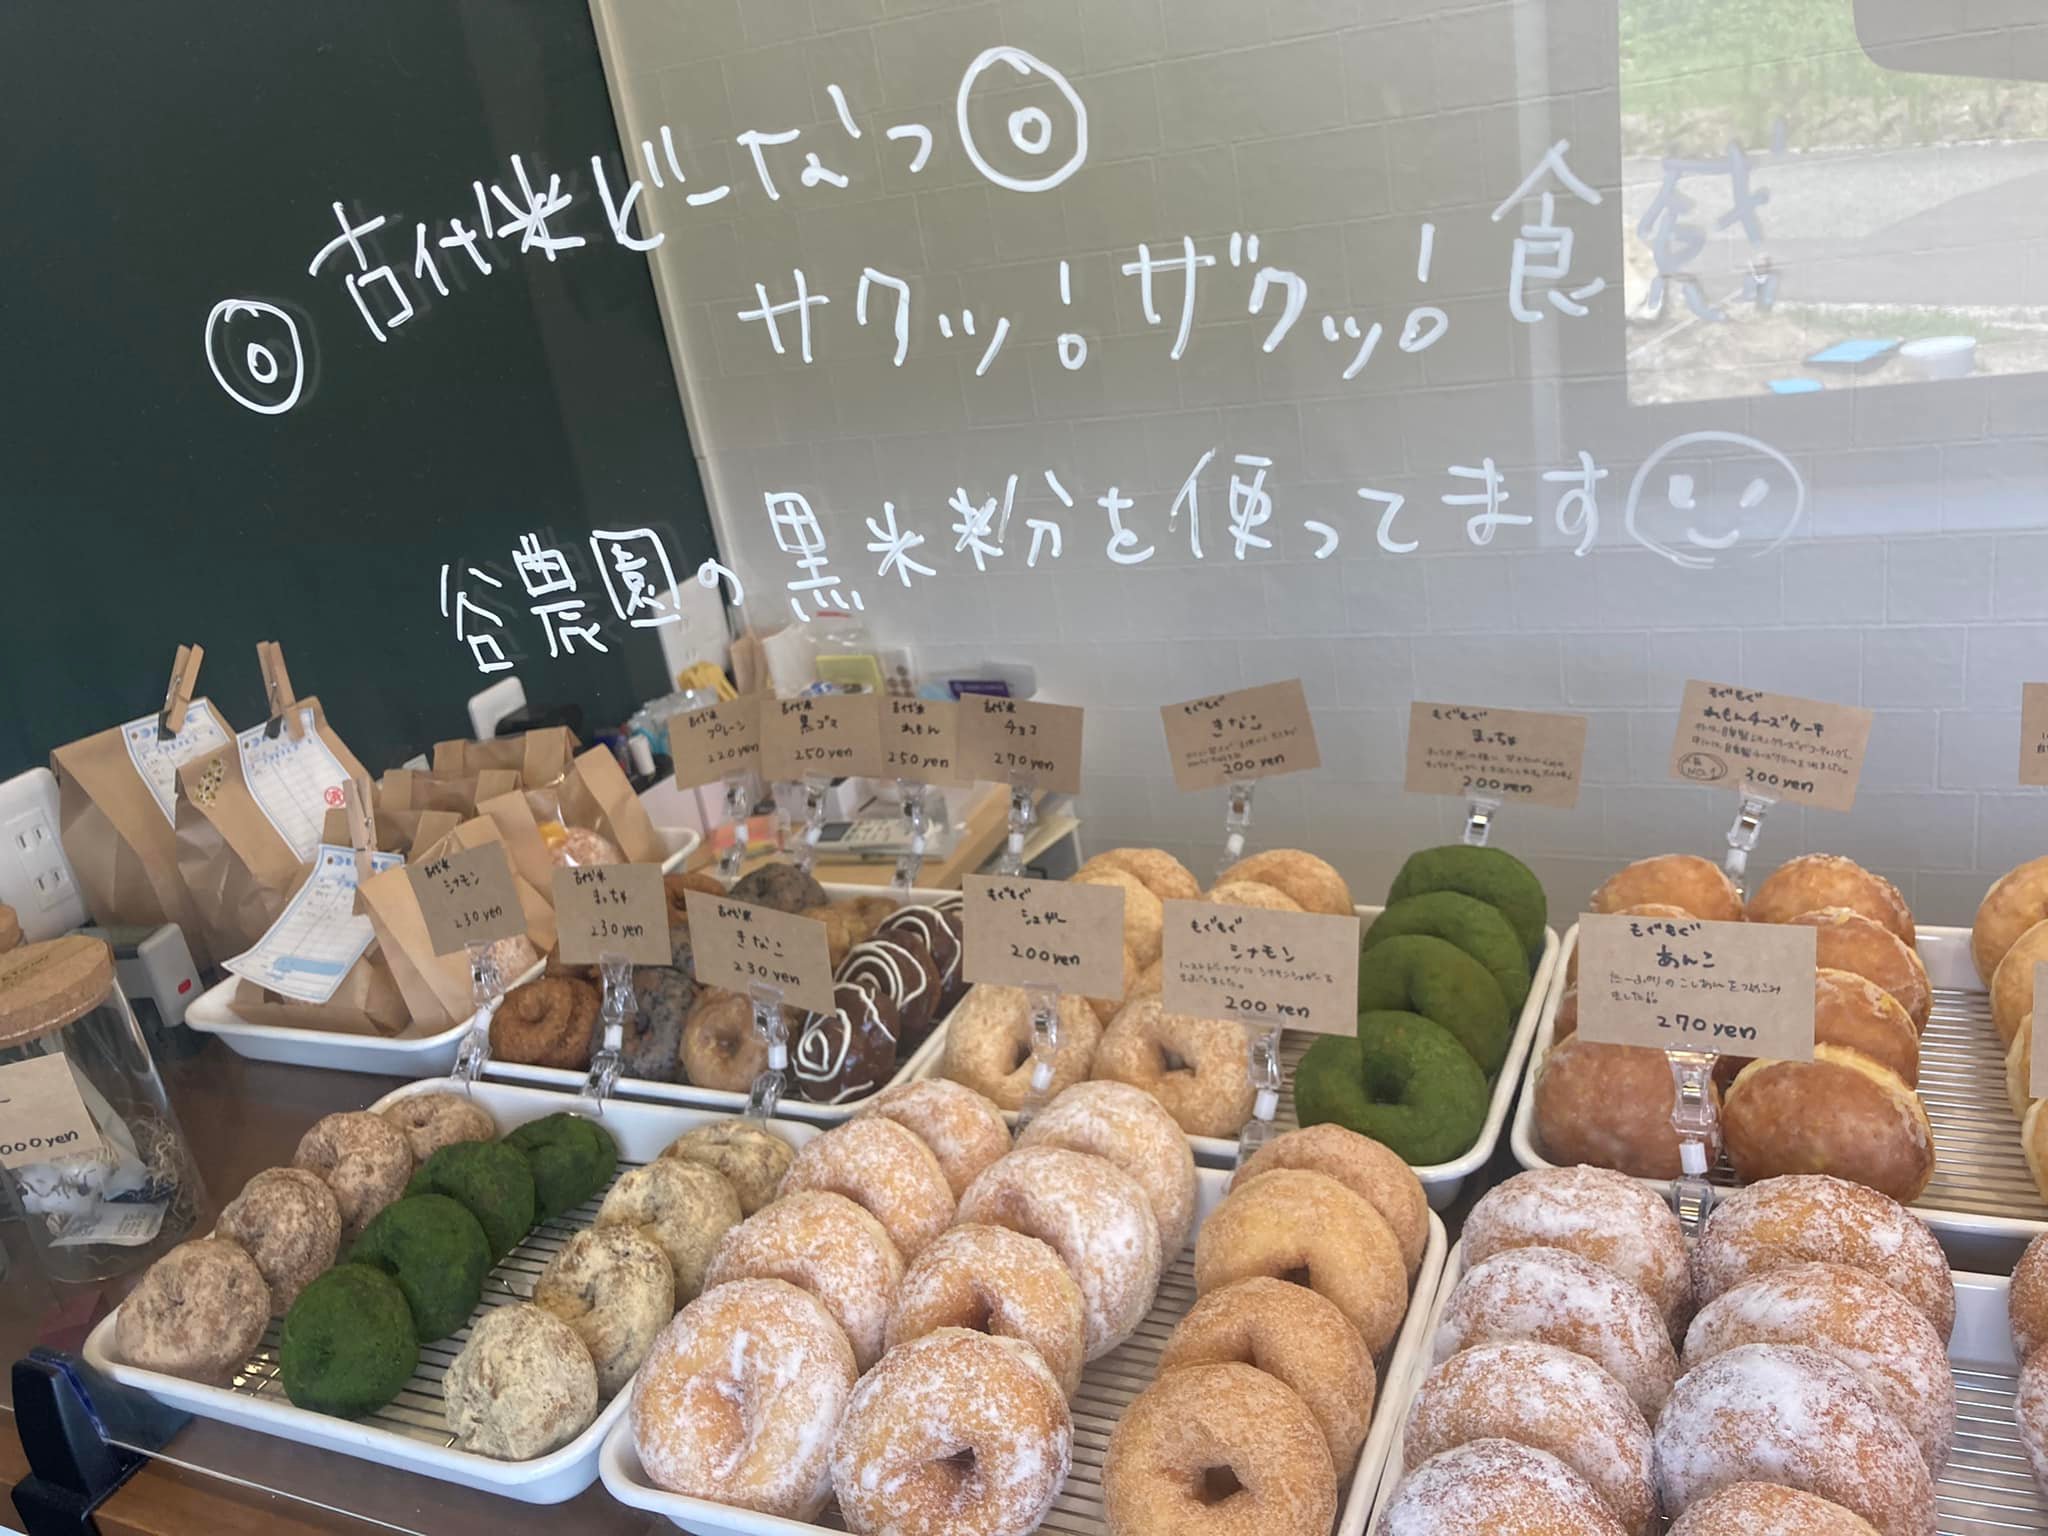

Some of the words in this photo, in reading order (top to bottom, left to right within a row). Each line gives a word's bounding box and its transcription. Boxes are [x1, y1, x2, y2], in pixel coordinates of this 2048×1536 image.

[1708, 687, 1764, 703] もぐもぐ
[987, 887, 1032, 902] もぐもぐ
[1191, 916, 1243, 934] もぐもぐ
[1630, 922, 1702, 938] もぐもぐ
[737, 930, 784, 957] きなこ
[1230, 943, 1295, 963] シナモン
[1656, 944, 1716, 969] あんこ
[1225, 996, 1268, 1012] 200
[1276, 1003, 1310, 1019] yen
[1656, 1013, 1707, 1032] 270
[1713, 1021, 1757, 1041] yen
